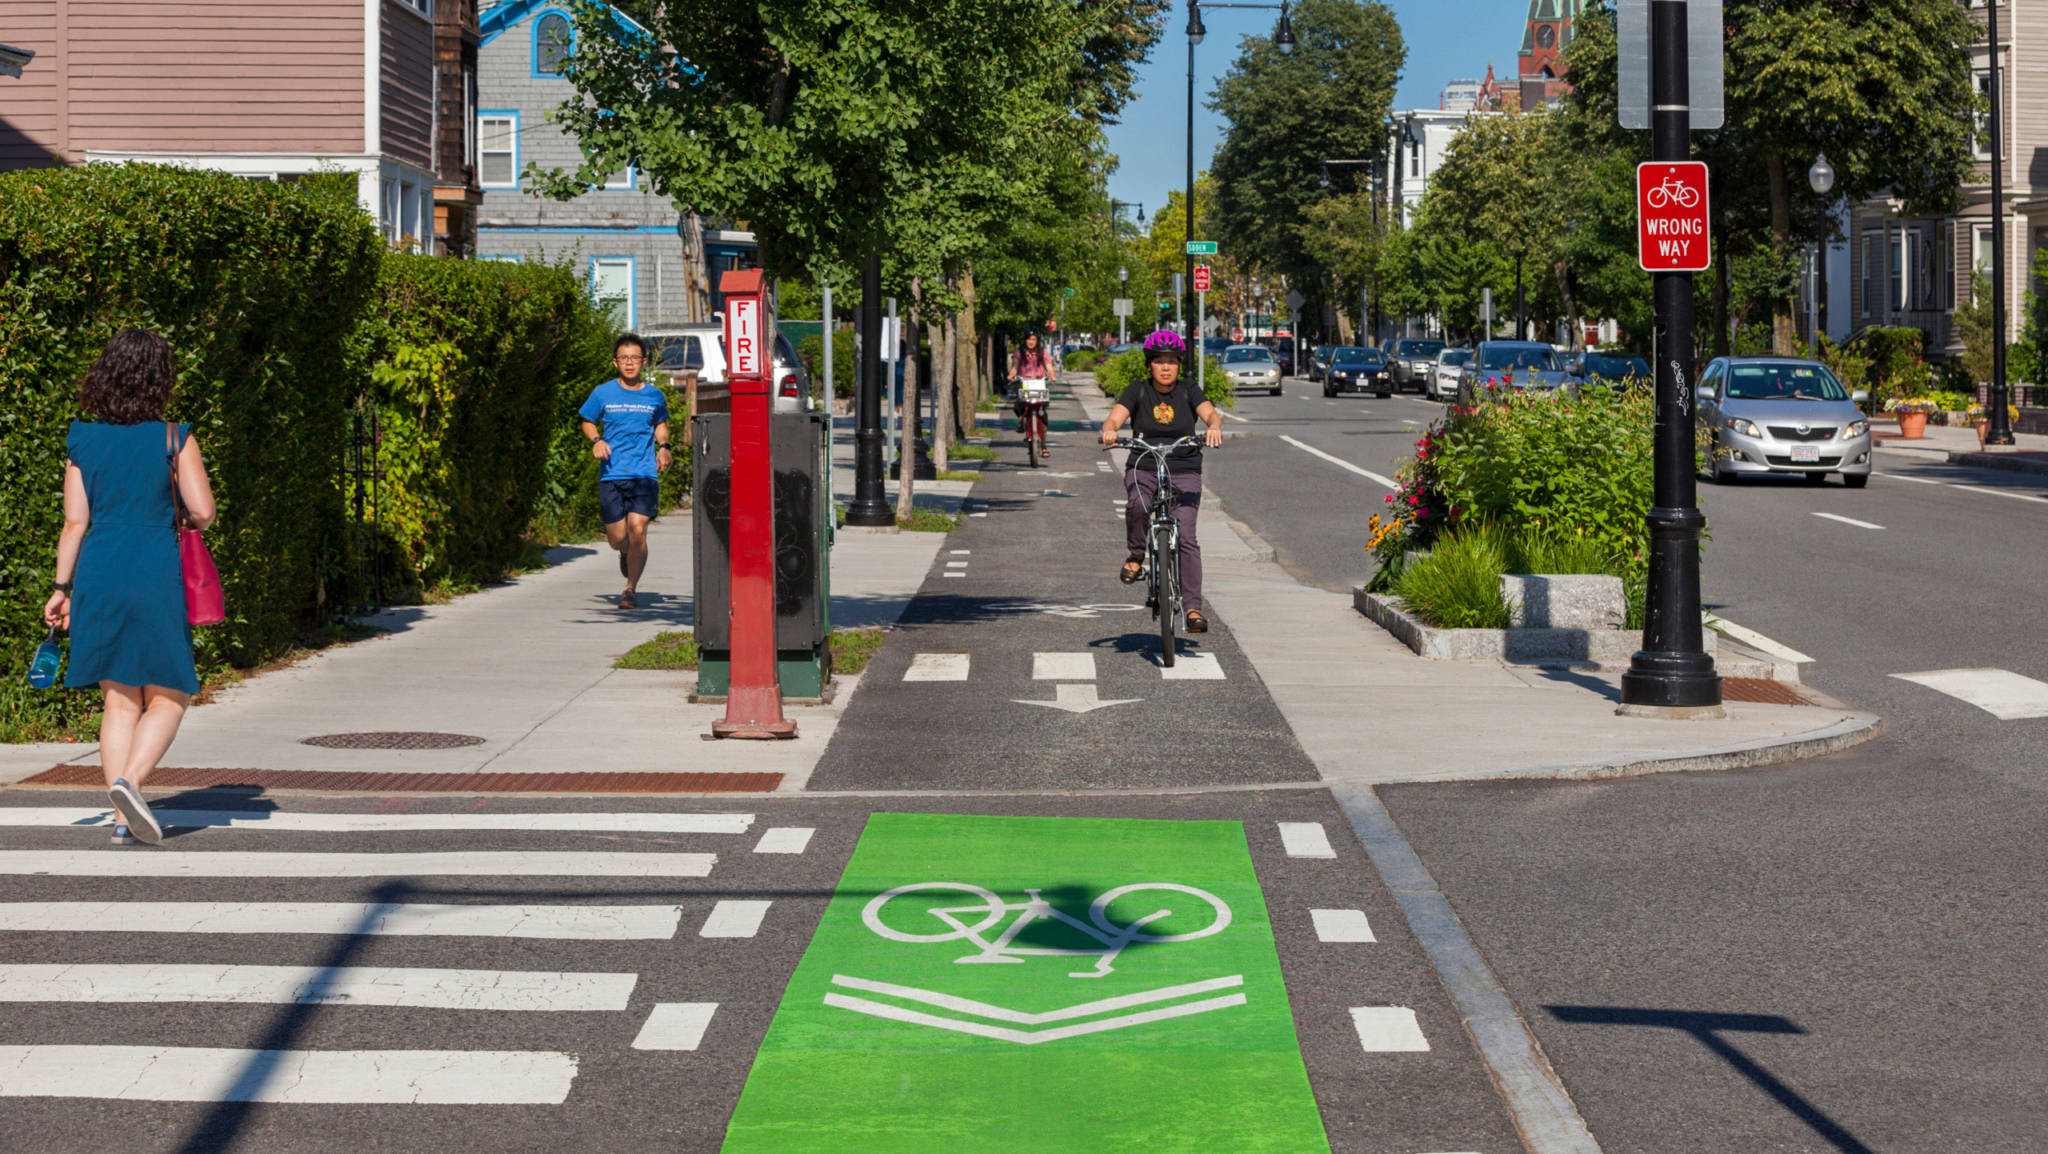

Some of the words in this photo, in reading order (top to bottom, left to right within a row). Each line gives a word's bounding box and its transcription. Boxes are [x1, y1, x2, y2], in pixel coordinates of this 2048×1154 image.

[1646, 218, 1702, 235] WRONG
[1658, 240, 1690, 256] WAY
[737, 301, 752, 371] FIRE
